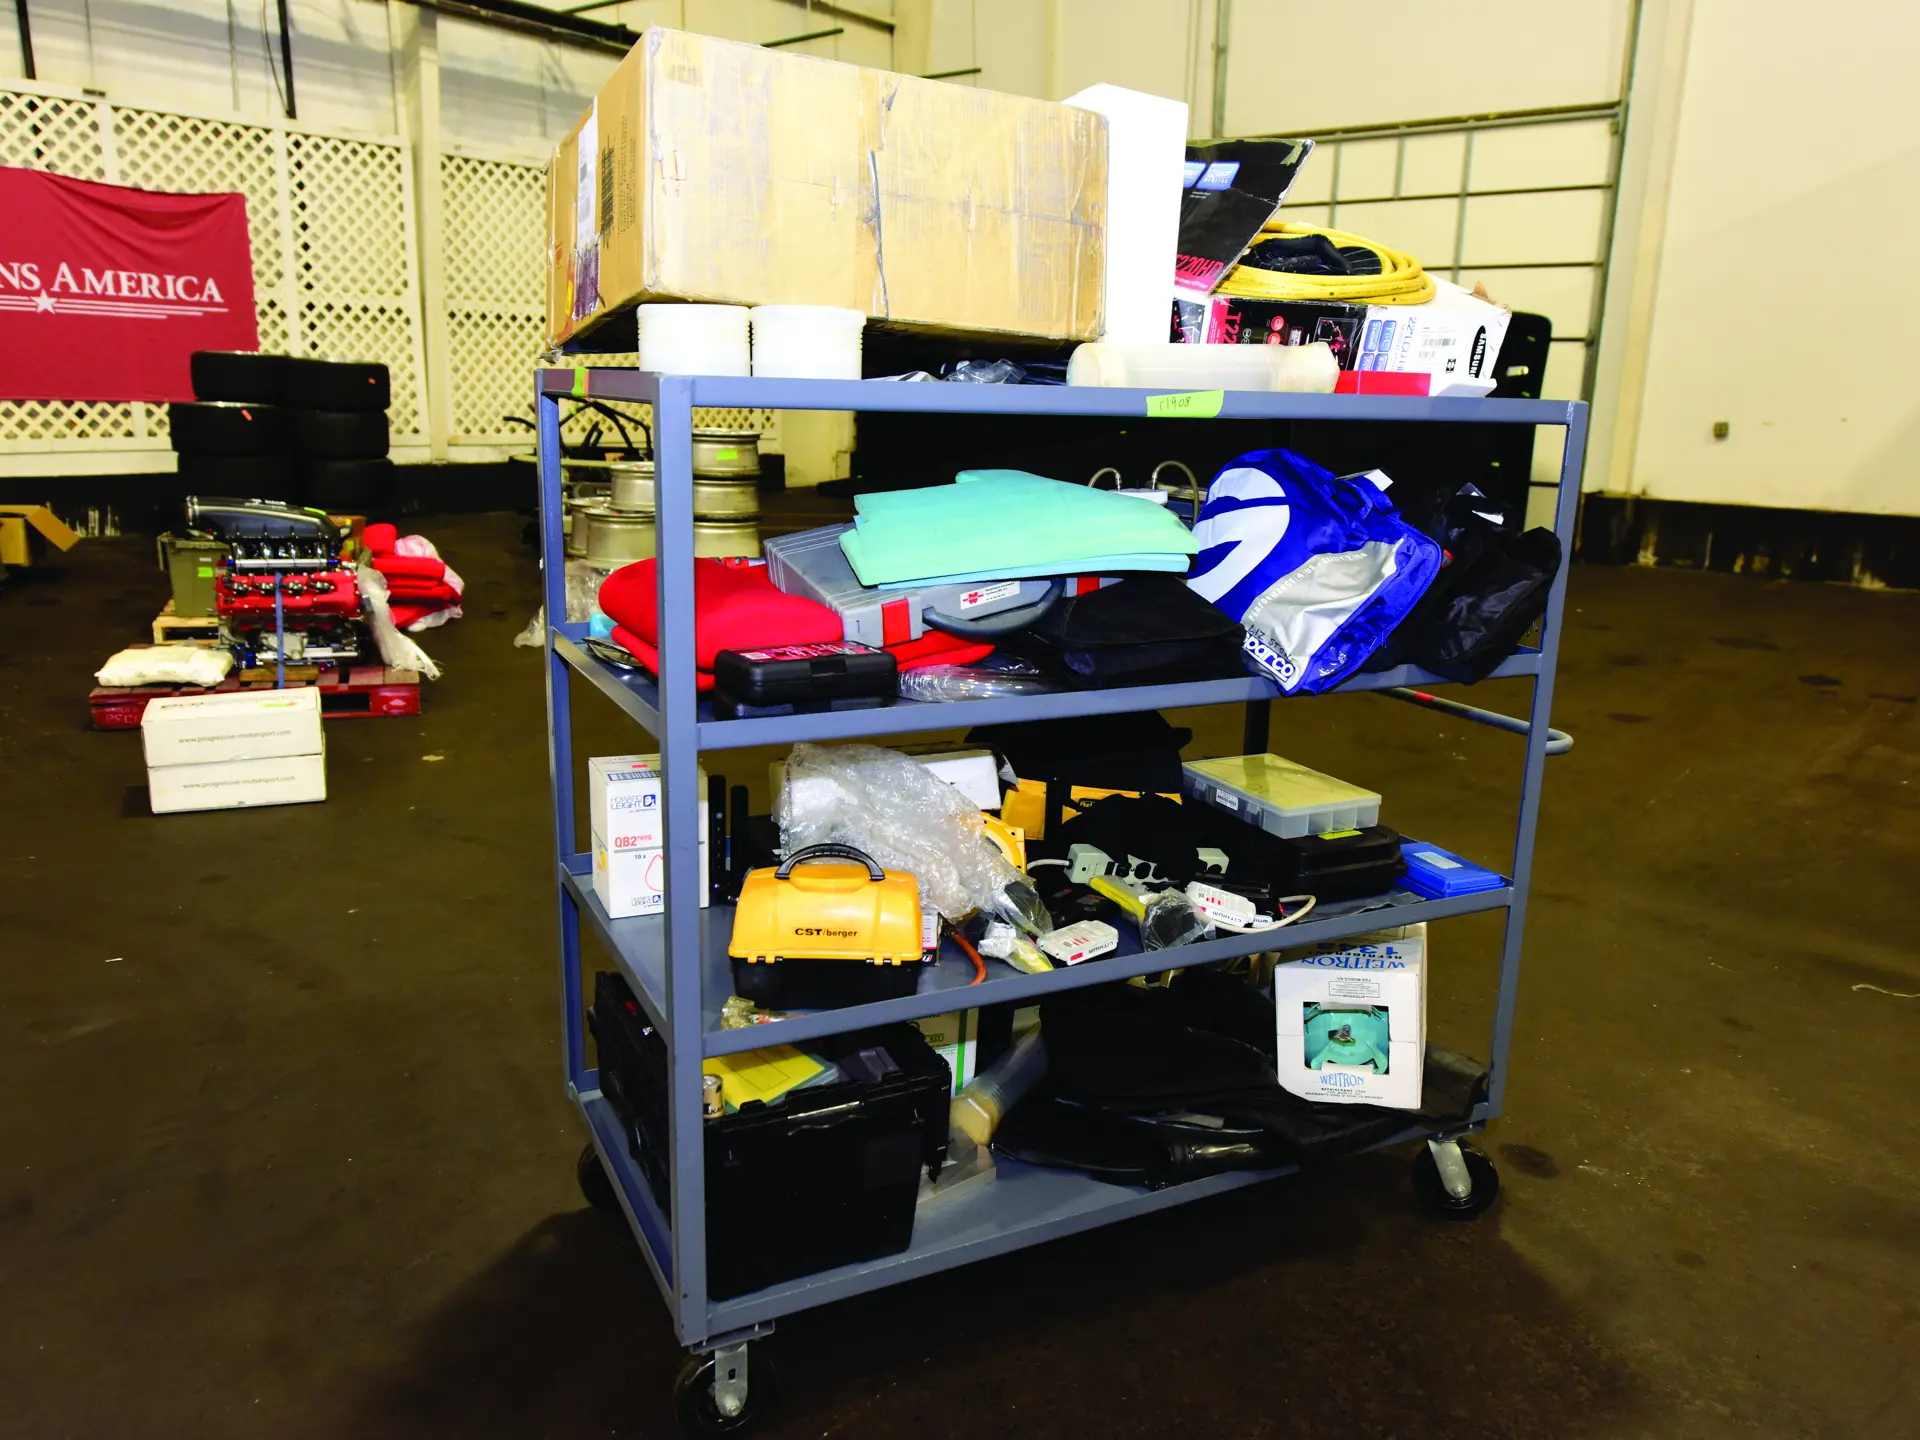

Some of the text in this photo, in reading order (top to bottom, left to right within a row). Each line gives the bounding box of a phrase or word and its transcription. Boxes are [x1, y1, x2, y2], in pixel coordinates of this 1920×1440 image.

[51, 261, 224, 303] AMERICA
[178, 729, 292, 744] www.progressive-motorsport.com
[182, 775, 295, 790] www.progressive-motorsport.com
[610, 800, 643, 810] LEIGHT
[1301, 956, 1406, 969] WEITRON
[1320, 1072, 1364, 1088] WEITRON
